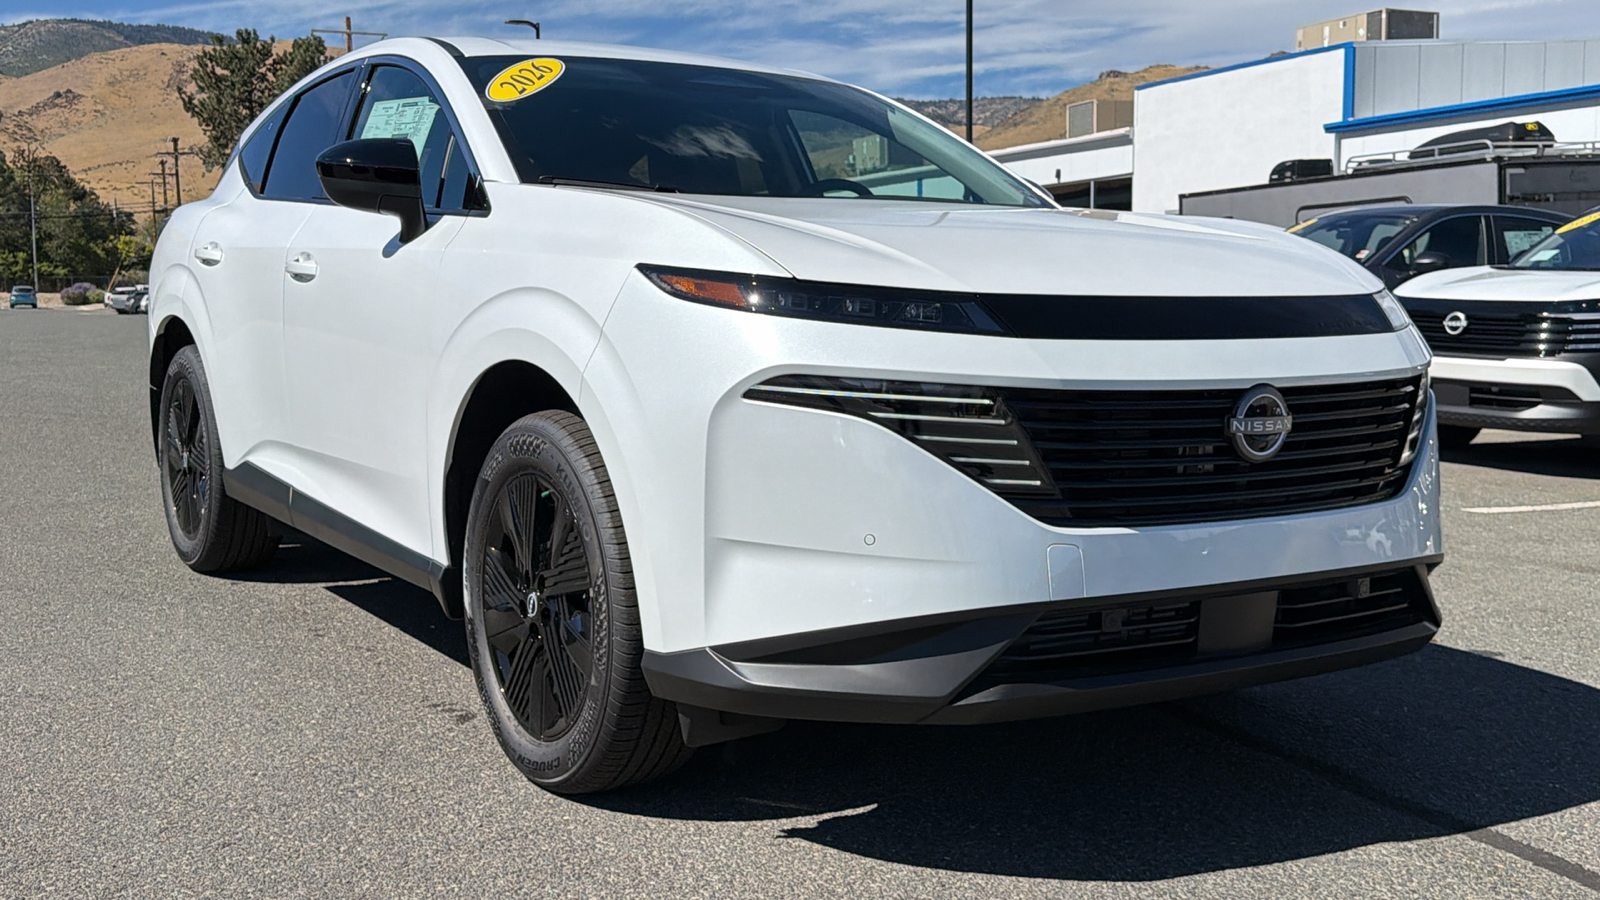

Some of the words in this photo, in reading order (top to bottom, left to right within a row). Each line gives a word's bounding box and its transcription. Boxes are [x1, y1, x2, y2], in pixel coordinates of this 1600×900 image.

[500, 62, 553, 95] 2026
[1233, 420, 1291, 431] NISSAN
[517, 754, 560, 771] CRUGEN
